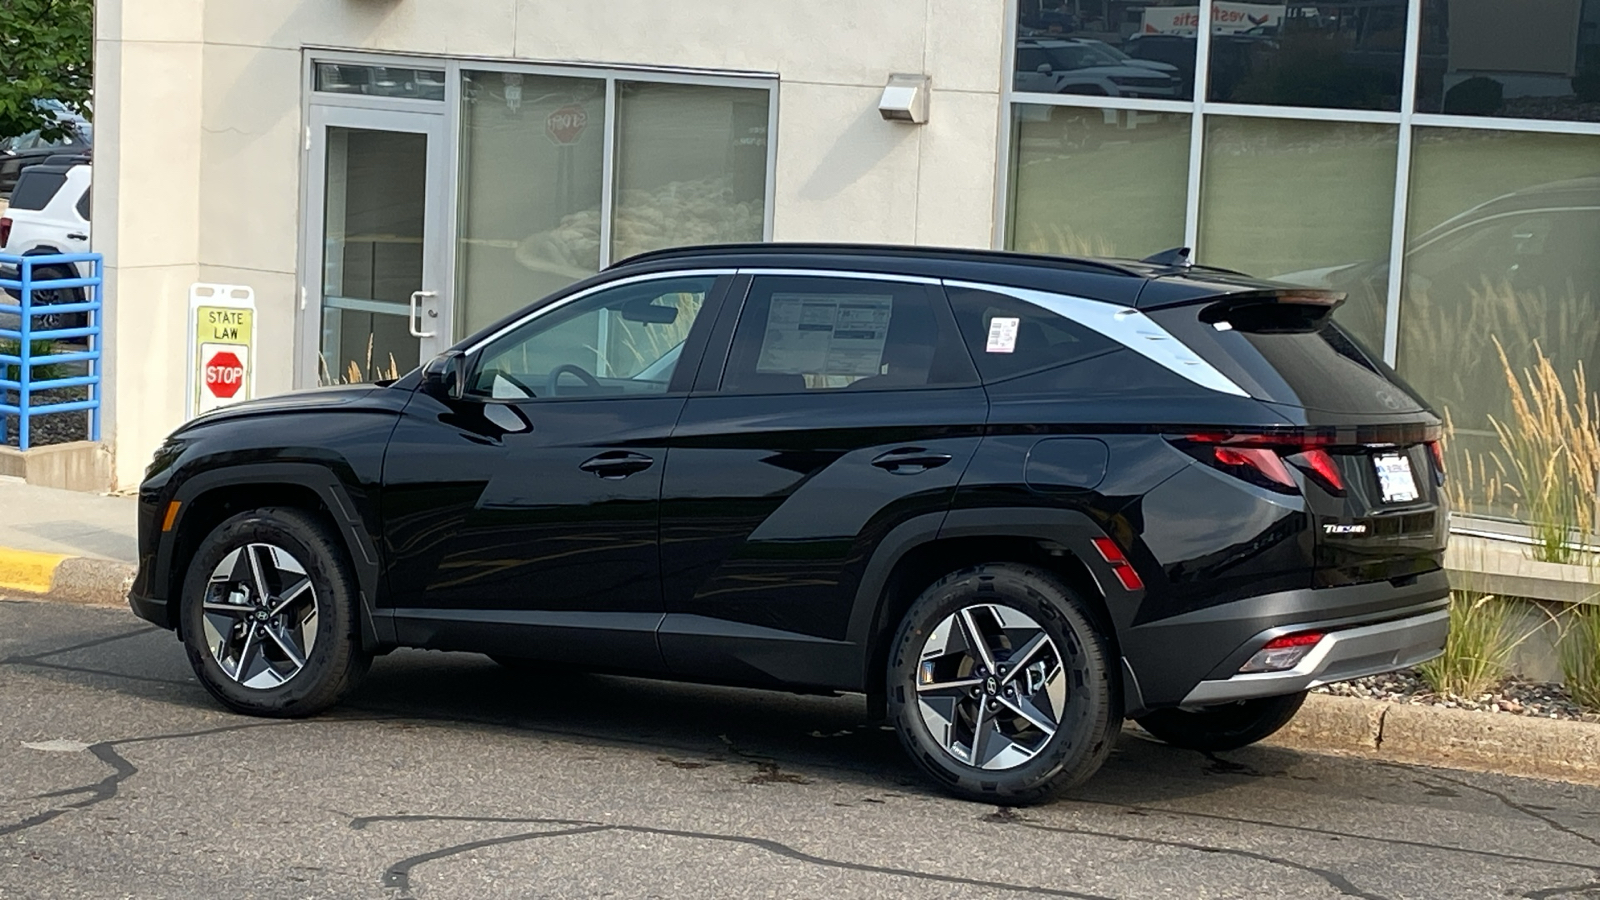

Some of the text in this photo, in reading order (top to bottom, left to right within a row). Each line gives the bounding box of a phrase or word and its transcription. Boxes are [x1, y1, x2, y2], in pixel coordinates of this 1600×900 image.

[209, 311, 243, 325] STATE
[214, 327, 238, 340] LAW
[207, 366, 242, 384] STOP
